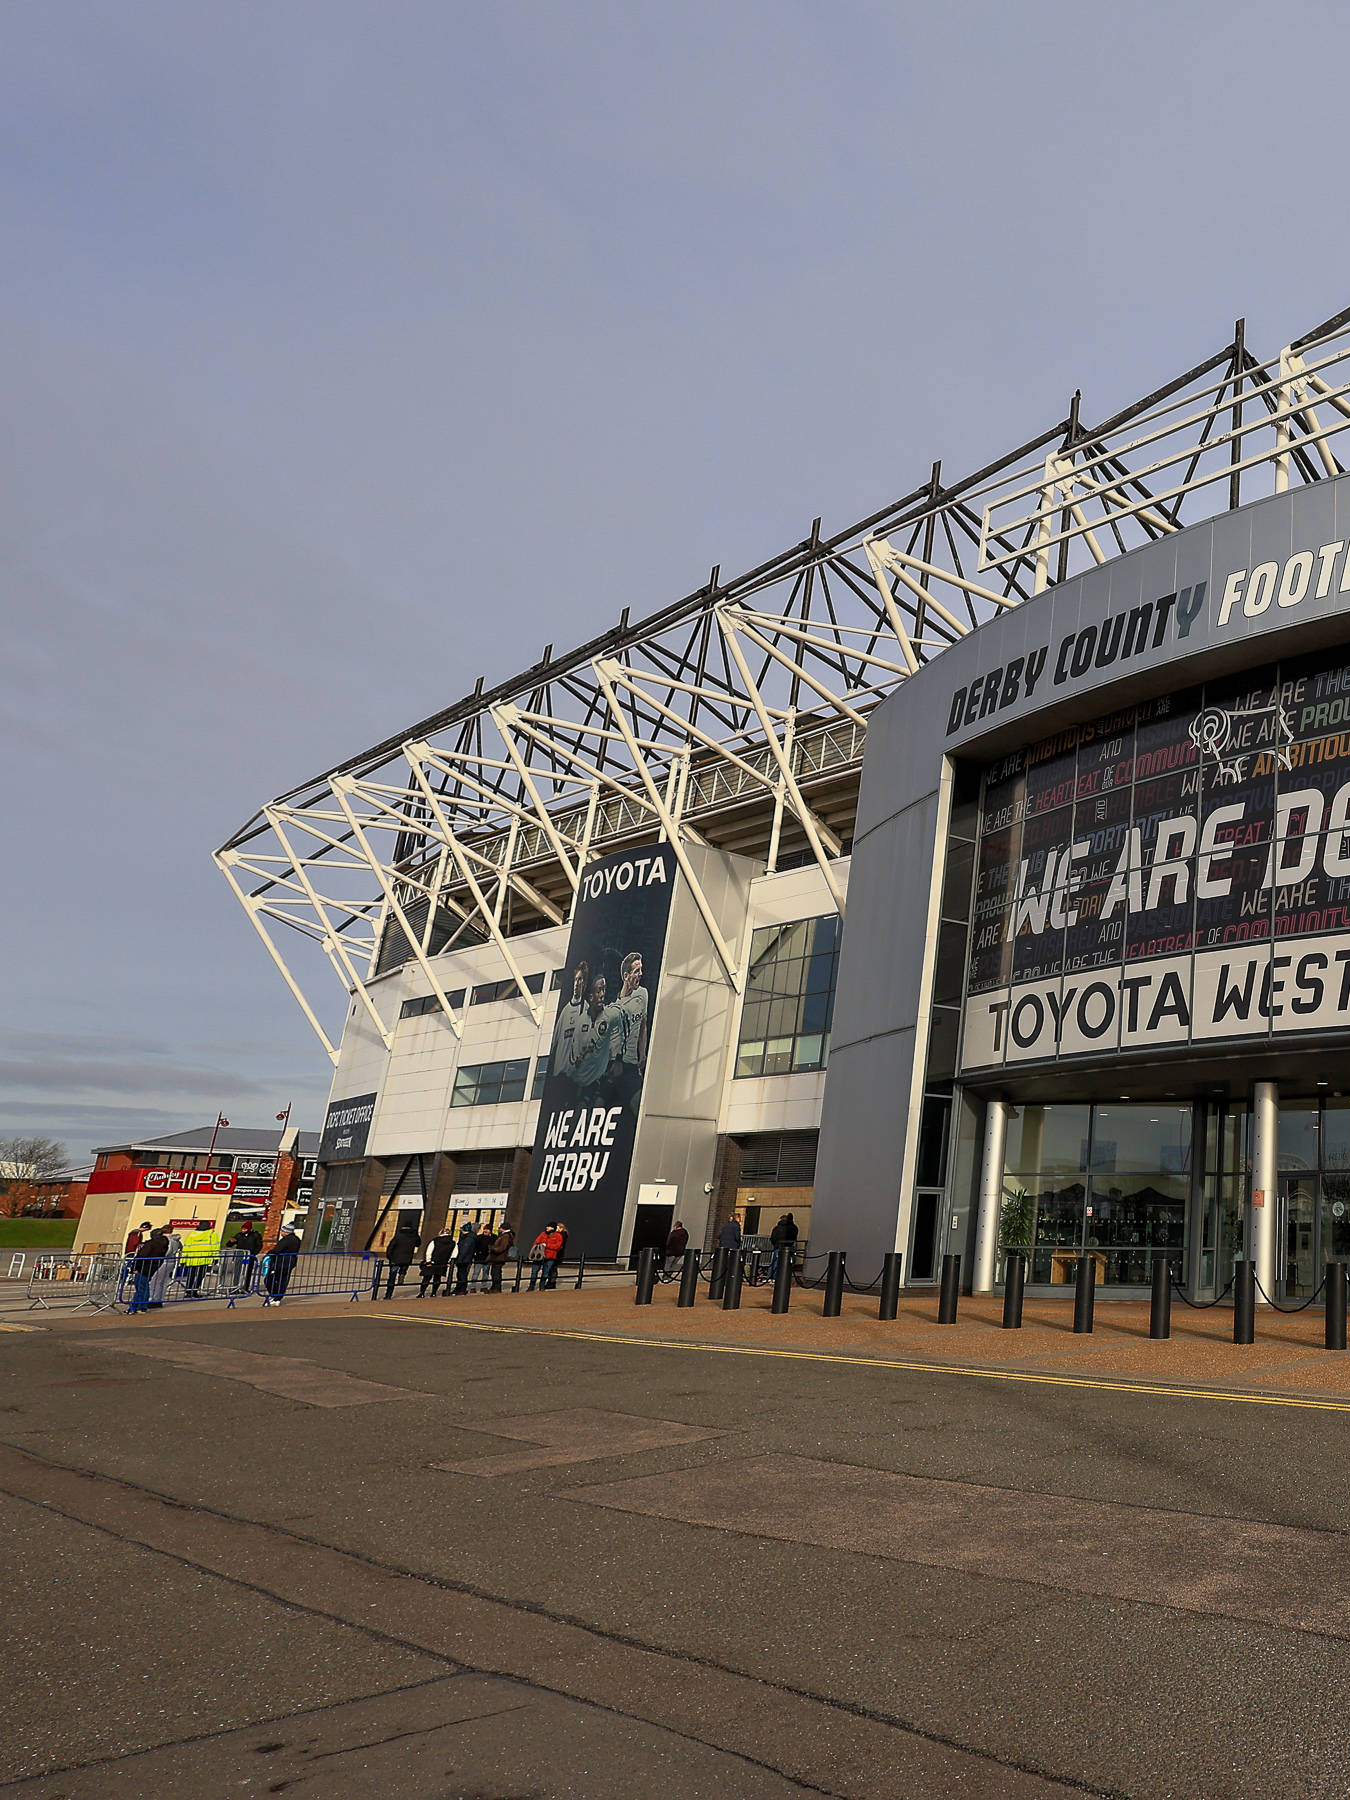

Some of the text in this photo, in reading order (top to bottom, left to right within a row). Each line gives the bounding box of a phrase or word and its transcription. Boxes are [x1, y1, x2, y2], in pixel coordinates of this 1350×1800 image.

[945, 645, 1049, 737] DERBY
[1053, 580, 1207, 687] COUNTY
[1267, 677, 1308, 707] ARE
[1098, 738, 1123, 762] AND
[1225, 721, 1255, 752] WE
[1102, 765, 1116, 781] OF
[993, 806, 1012, 828] ARE
[583, 856, 667, 903] TOYOTA
[1005, 840, 1092, 943] WE
[1099, 802, 1246, 921] ARE
[1239, 889, 1269, 918] WE
[976, 922, 1000, 950] ARE
[1097, 921, 1122, 944] AND
[1207, 926, 1222, 944] OF
[988, 966, 1191, 1052] TOYOTA
[354, 1104, 374, 1124] OFFICE
[543, 1106, 623, 1150] WE ARE
[145, 1171, 233, 1191] CHIPS
[537, 1151, 611, 1193] DERBY
